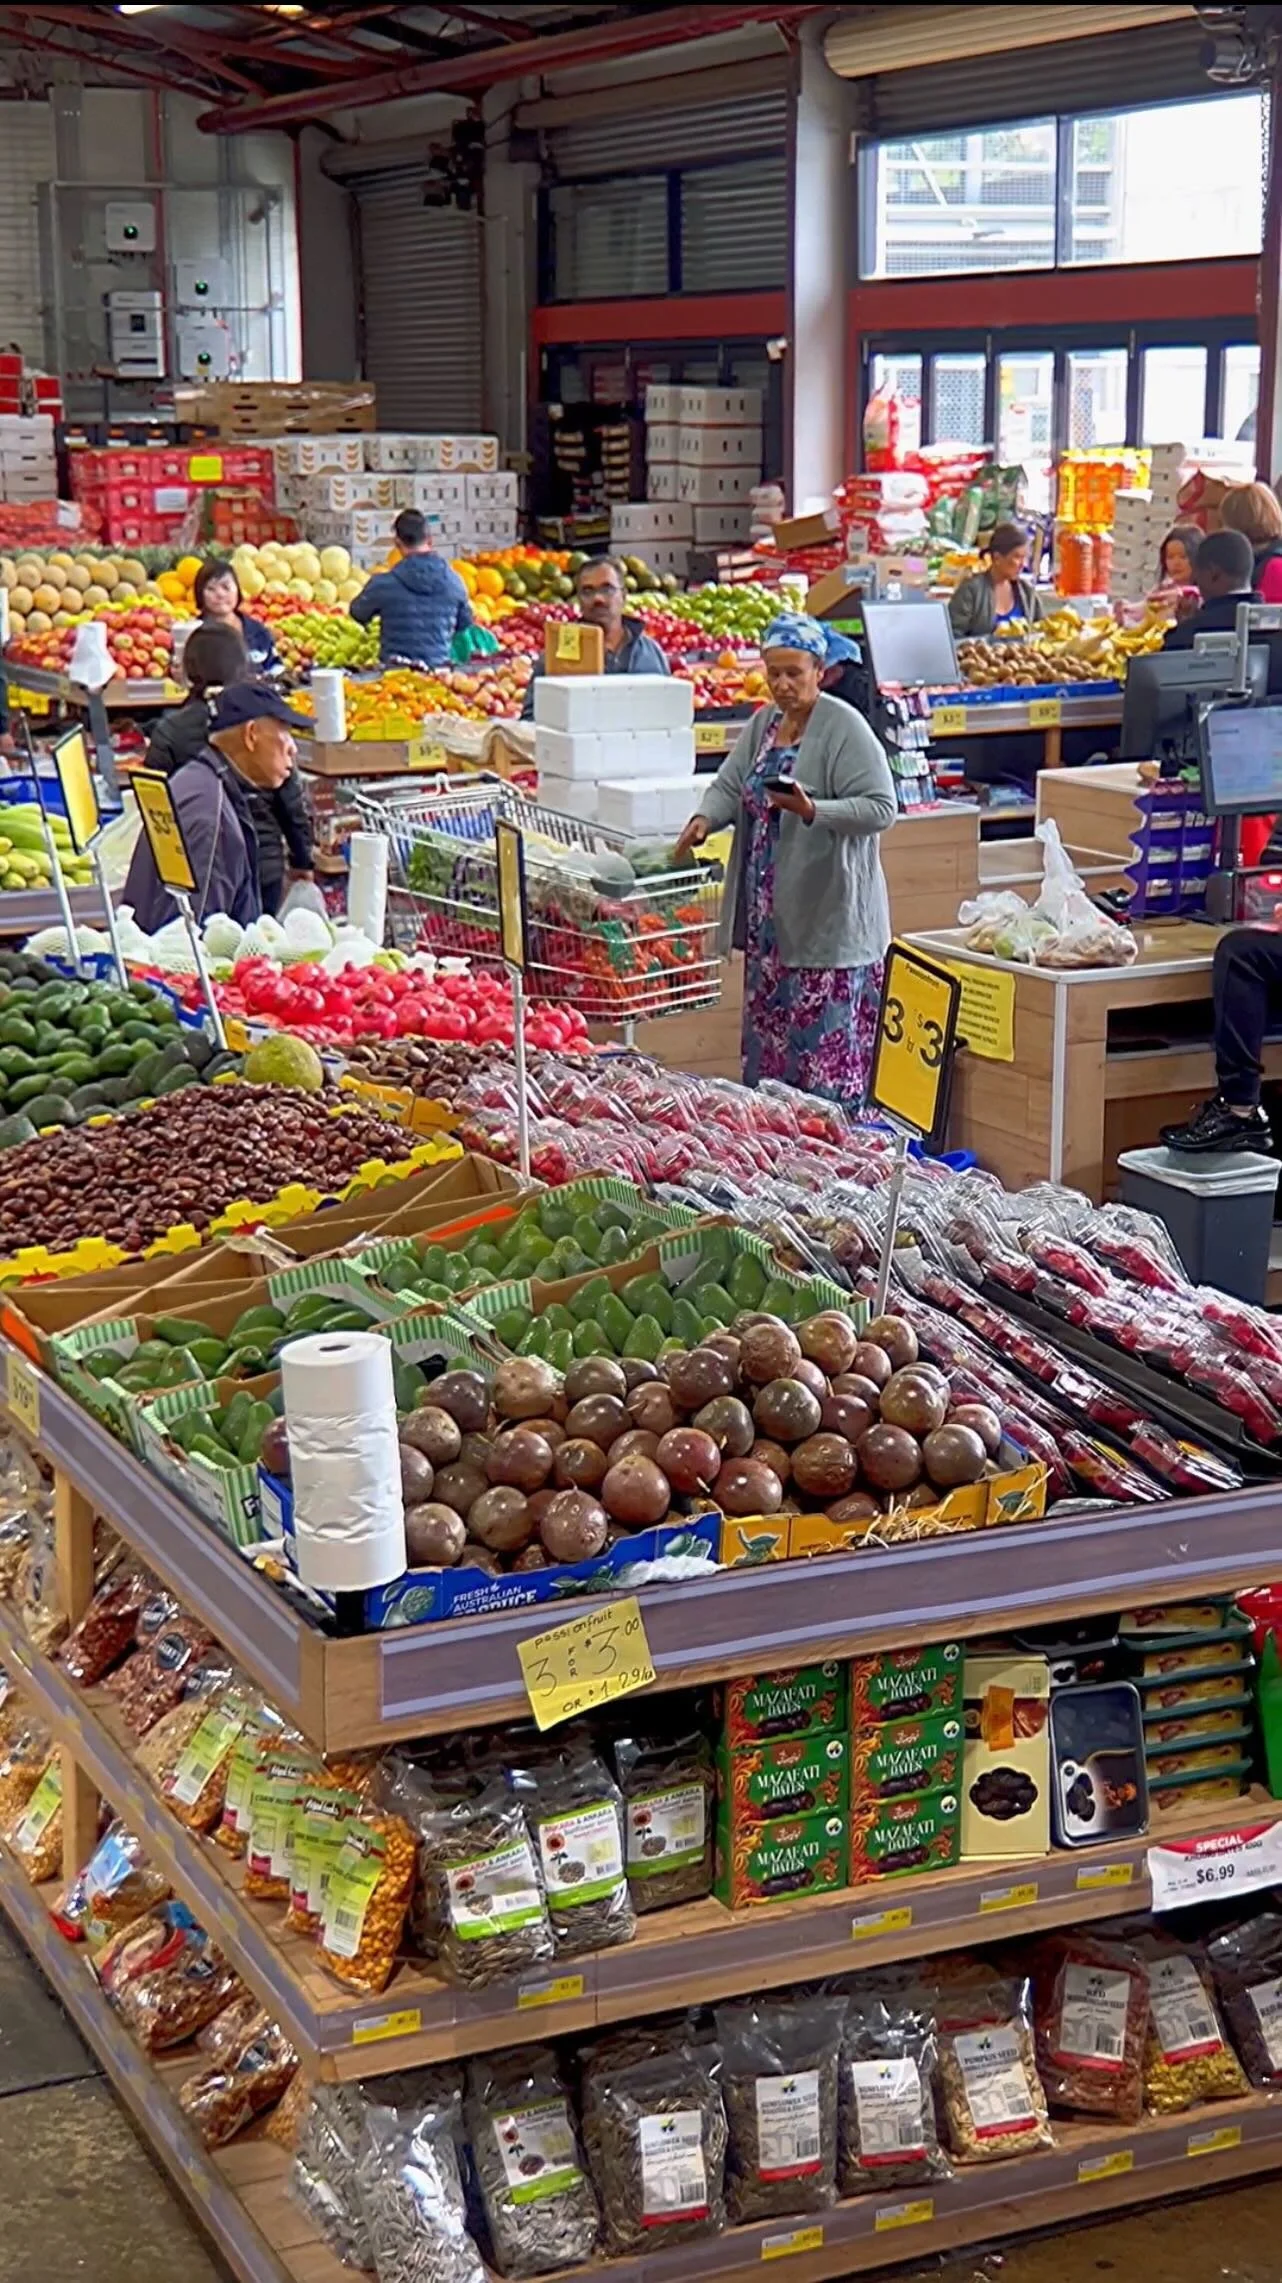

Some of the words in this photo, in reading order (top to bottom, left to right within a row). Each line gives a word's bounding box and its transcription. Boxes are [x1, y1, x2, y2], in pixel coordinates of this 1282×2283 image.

[883, 997, 905, 1044] 3
[453, 1587, 489, 1604] FRESH
[453, 1585, 521, 1613] AUSTRALIAN
[526, 1657, 558, 1698] 3
[876, 1668, 937, 1691] MAZAFATI
[752, 1684, 817, 1707] MAZAFATI
[890, 1683, 924, 1699] DATES
[562, 1699, 583, 1713] OR
[767, 1700, 802, 1717] DATES
[876, 1744, 938, 1767] MAZAFATI
[757, 1764, 820, 1788] MAZAFATI
[890, 1760, 923, 1777] DATES
[771, 1780, 806, 1797] DATES
[873, 1819, 935, 1844] MAZAFATI
[757, 1841, 820, 1866] MAZAFATI
[888, 1836, 920, 1851] DATES
[1195, 1834, 1244, 1853] SPECIAL
[771, 1859, 806, 1875] DATES
[1196, 1863, 1236, 1885] $6.99
[964, 2053, 997, 2065] PUMPKIN
[998, 2048, 1018, 2058] SEED
